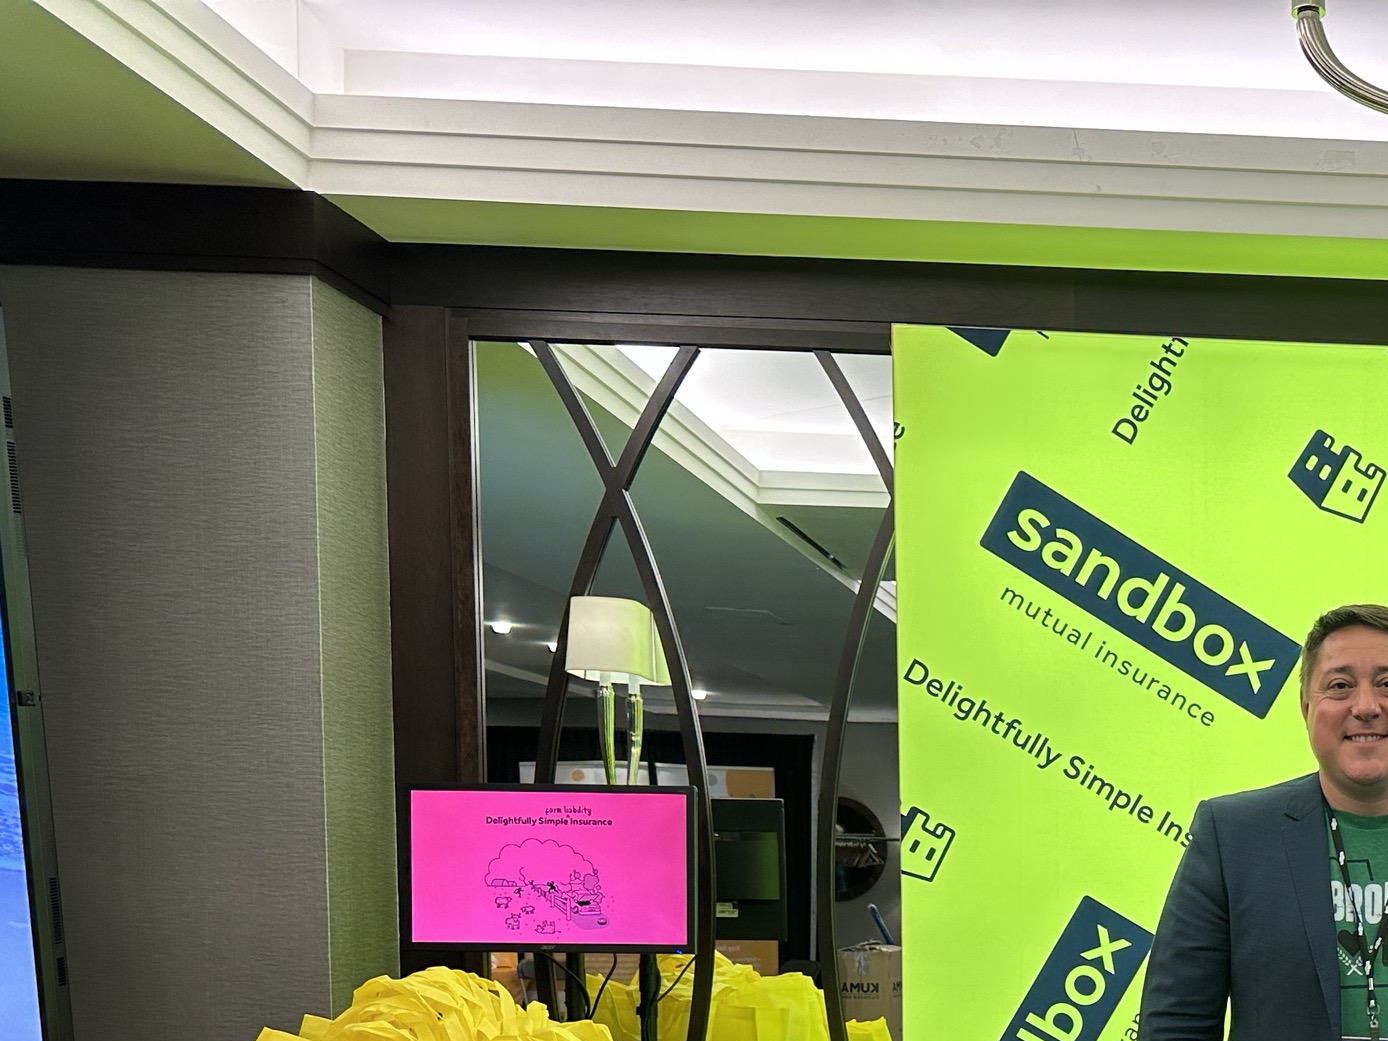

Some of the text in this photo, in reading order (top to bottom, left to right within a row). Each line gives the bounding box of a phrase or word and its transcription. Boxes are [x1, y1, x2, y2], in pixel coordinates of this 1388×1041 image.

[1000, 585, 1215, 728] mutual insurance
[1007, 507, 1274, 694] sandbox
[903, 658, 1062, 771] Delightfully
[1062, 754, 1155, 827] Simple
[486, 816, 613, 826] Delightfully Simple Insurance
